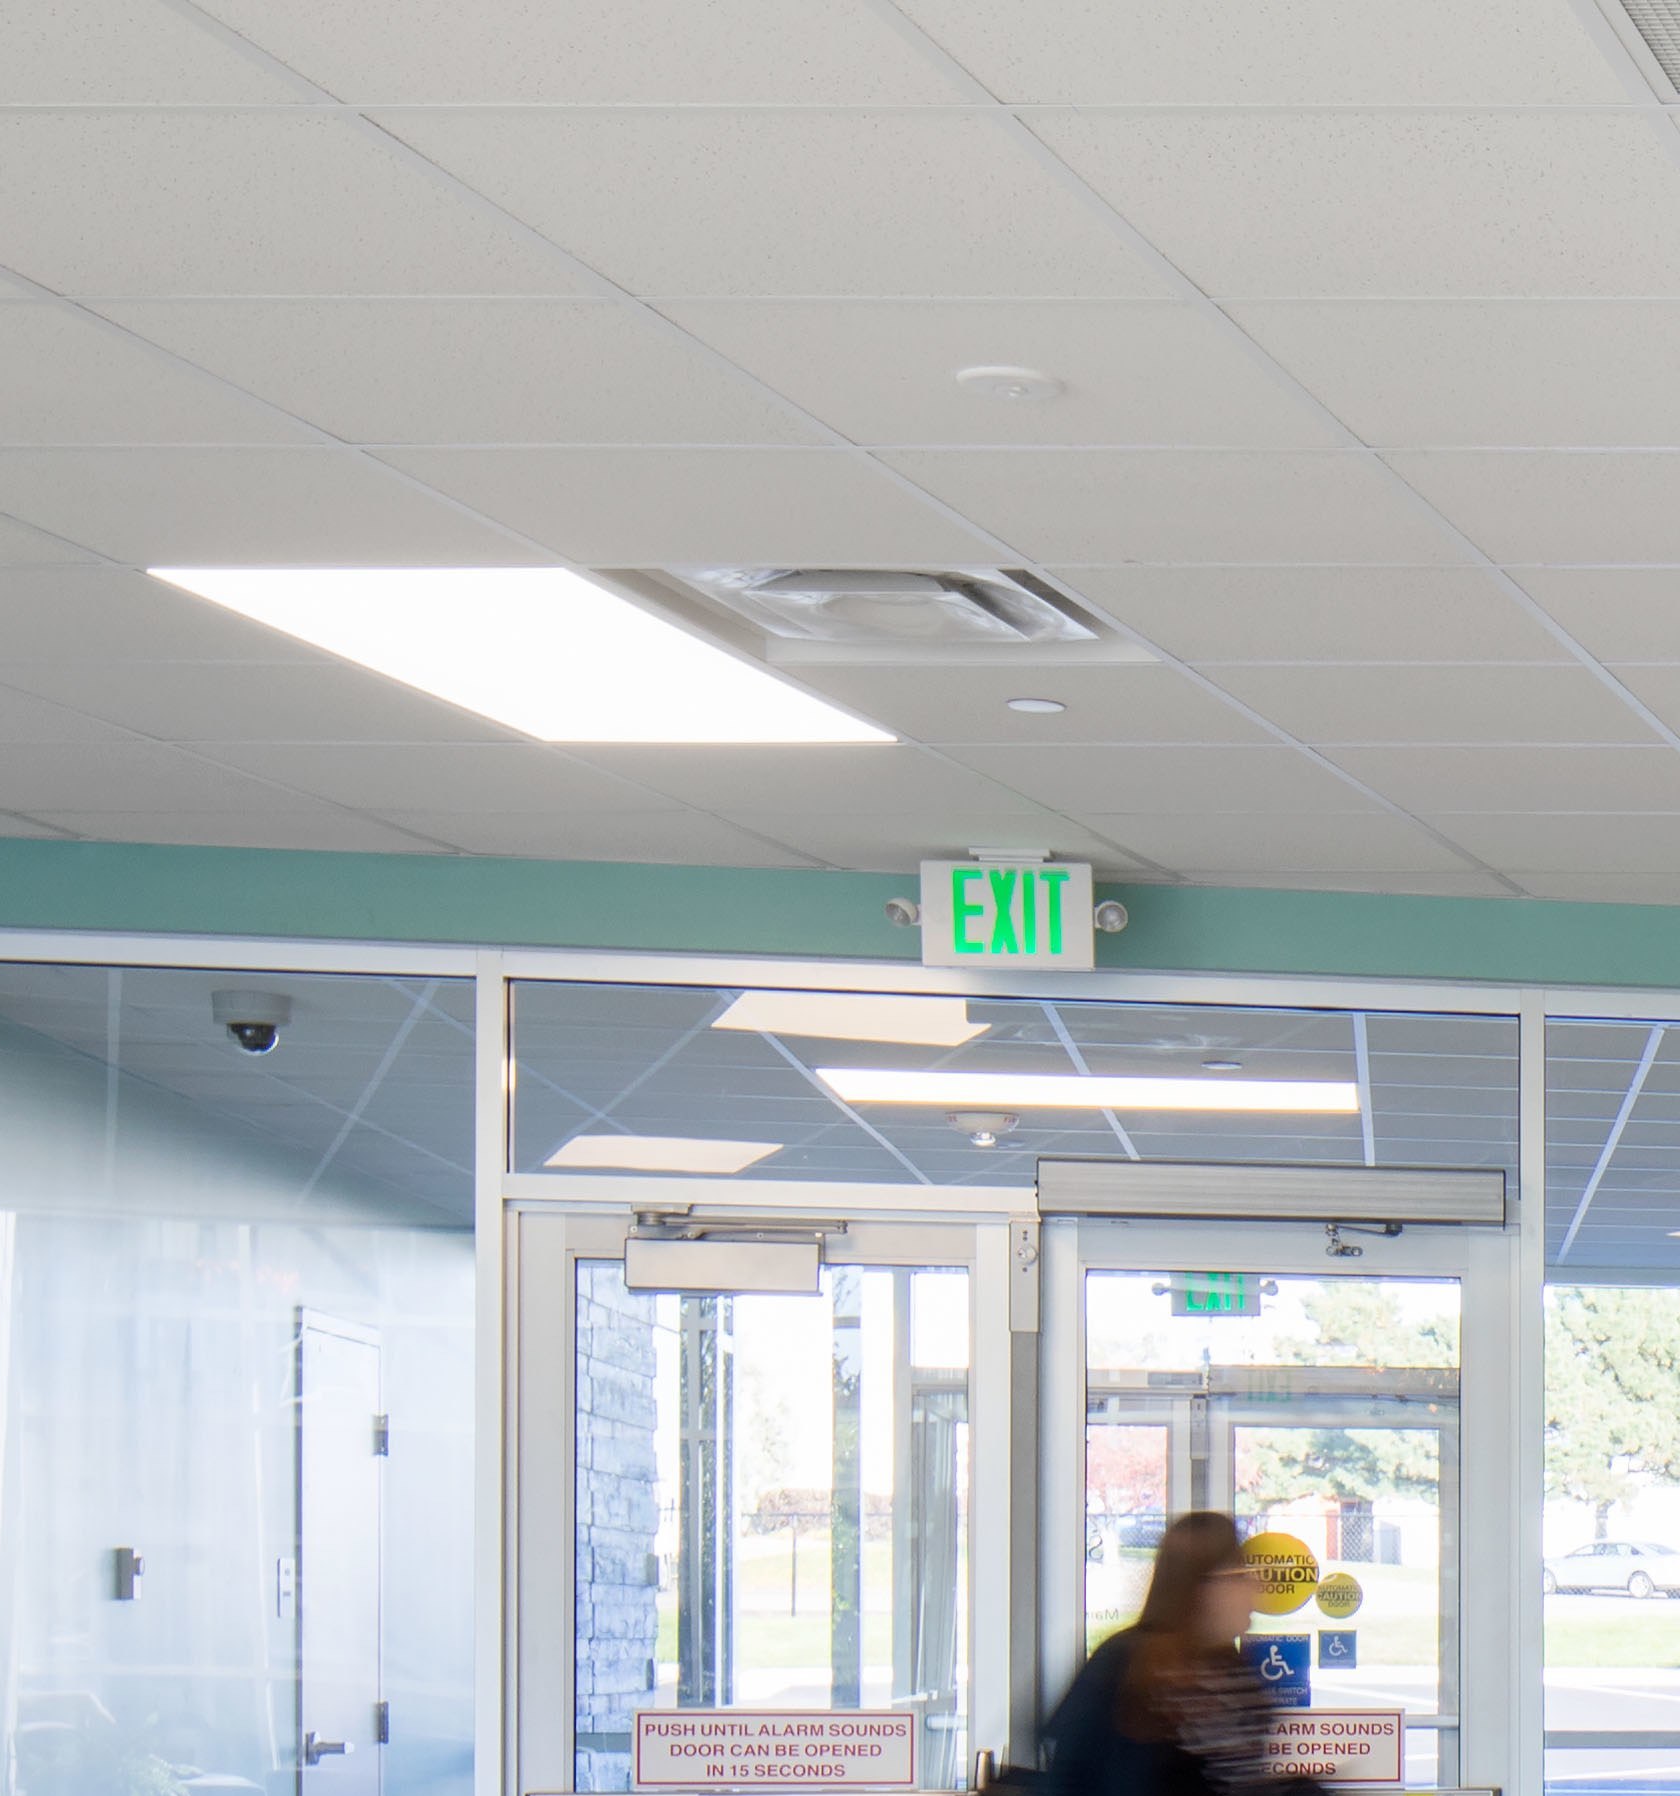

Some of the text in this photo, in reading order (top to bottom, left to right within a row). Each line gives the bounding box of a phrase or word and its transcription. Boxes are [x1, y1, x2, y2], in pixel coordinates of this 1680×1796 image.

[952, 868, 1070, 954] EXIT
[645, 1723, 907, 1737] PUSH UNTIL ALARM SOUNDS
[1319, 1722, 1394, 1736] SOUNDS
[670, 1743, 882, 1757] DOOR CAN BE OPENED
[1269, 1742, 1371, 1756] BE OPENED
[706, 1764, 846, 1777] IN 15 SECONDS
[1260, 1762, 1337, 1775] ECONDS
